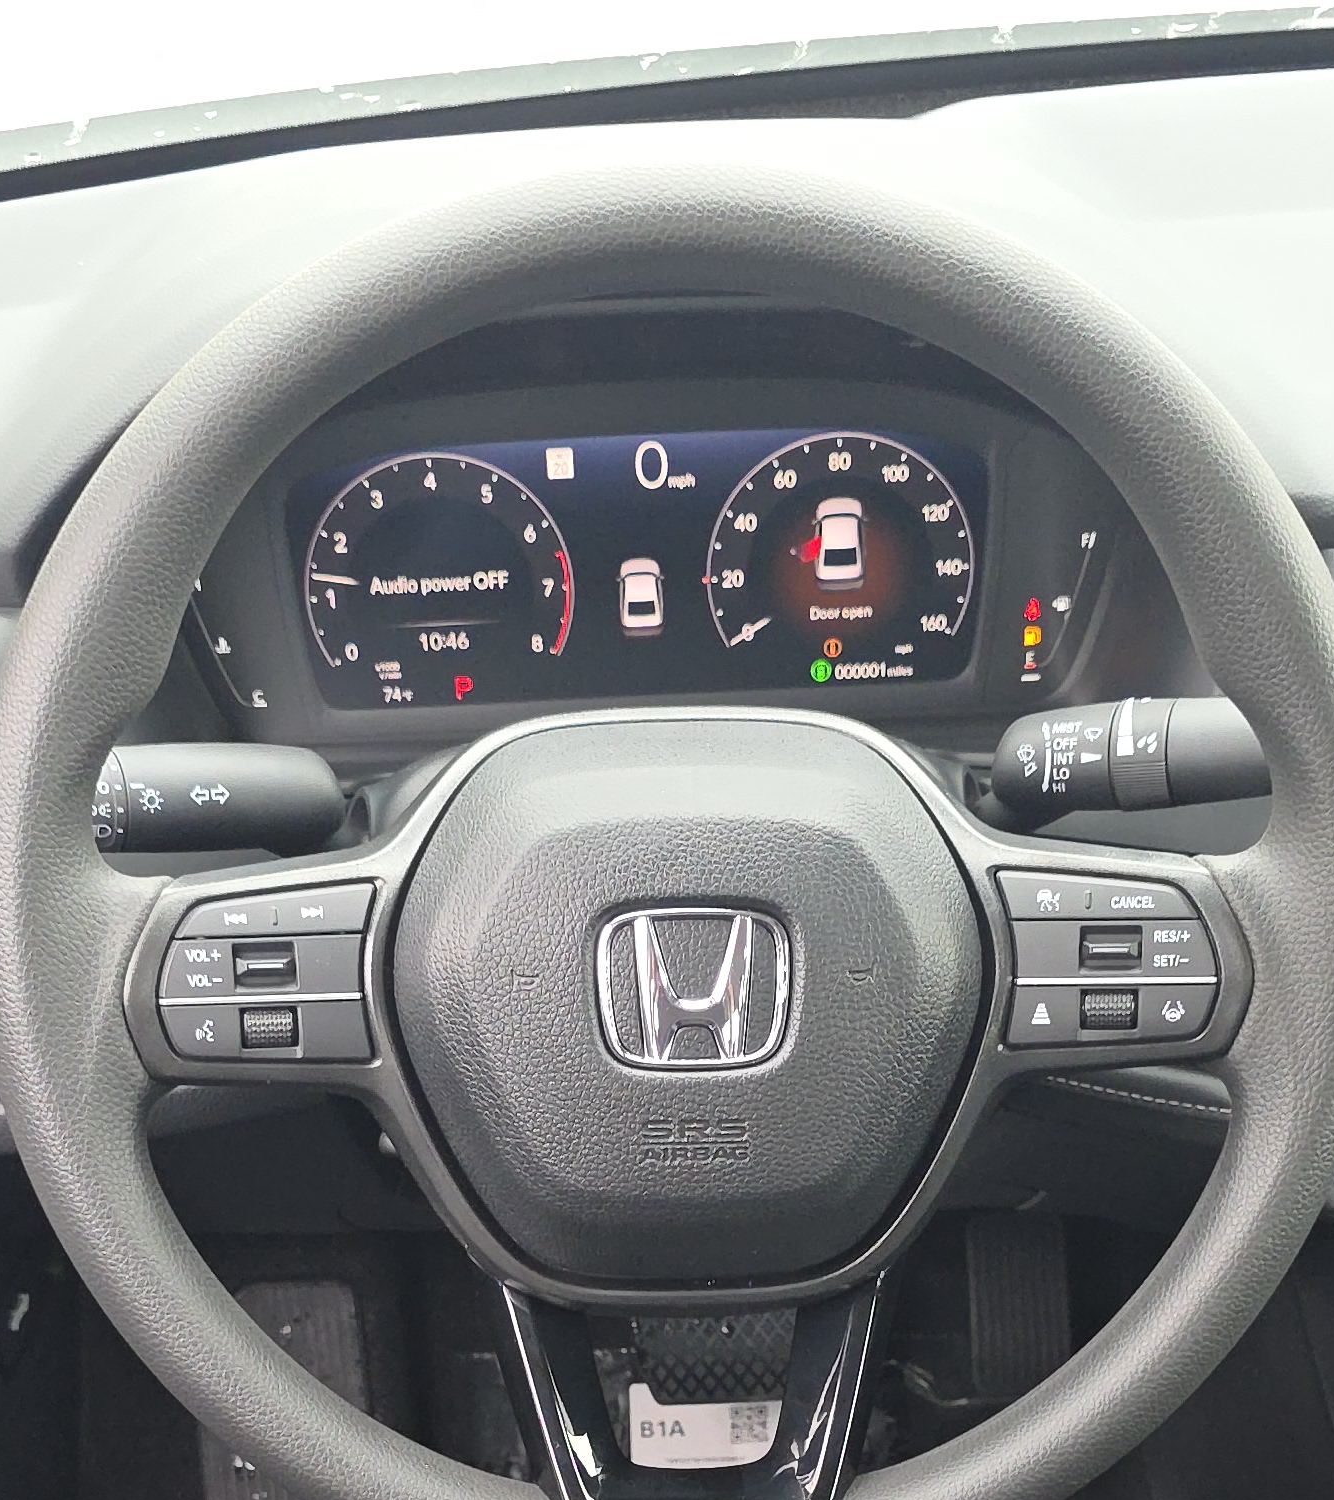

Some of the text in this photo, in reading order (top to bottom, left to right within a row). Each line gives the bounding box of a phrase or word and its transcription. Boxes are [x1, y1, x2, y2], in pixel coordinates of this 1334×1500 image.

[634, 440, 696, 490] 0 mph
[827, 451, 852, 472] 80
[423, 471, 438, 491] 4
[773, 468, 798, 489] 60
[881, 463, 910, 484] 100
[369, 489, 385, 510] 3
[480, 483, 494, 504] 5
[733, 512, 759, 533] 40
[921, 503, 949, 523] 120
[333, 531, 348, 554] 2
[523, 523, 537, 544] 6
[935, 558, 964, 577] 140
[369, 569, 509, 597] Audio power OFF
[541, 577, 555, 598] 7
[720, 569, 745, 589] 20
[325, 587, 337, 609] 1
[809, 604, 874, 621] Door open
[920, 613, 948, 633] 160
[417, 630, 471, 652] 10:46
[530, 634, 545, 653] 8
[344, 642, 360, 662] 0
[834, 661, 915, 680] 000001 miles
[454, 675, 474, 700] P
[1051, 720, 1082, 735] MIST
[1052, 736, 1078, 751] OFF
[1053, 752, 1075, 767] INT
[1053, 766, 1070, 781] LO
[1052, 781, 1067, 794] HI
[1110, 895, 1156, 911] CANCEL
[641, 1119, 748, 1141] SRS
[641, 1145, 751, 1164] AIRBAG
[639, 1419, 687, 1439] B1A
